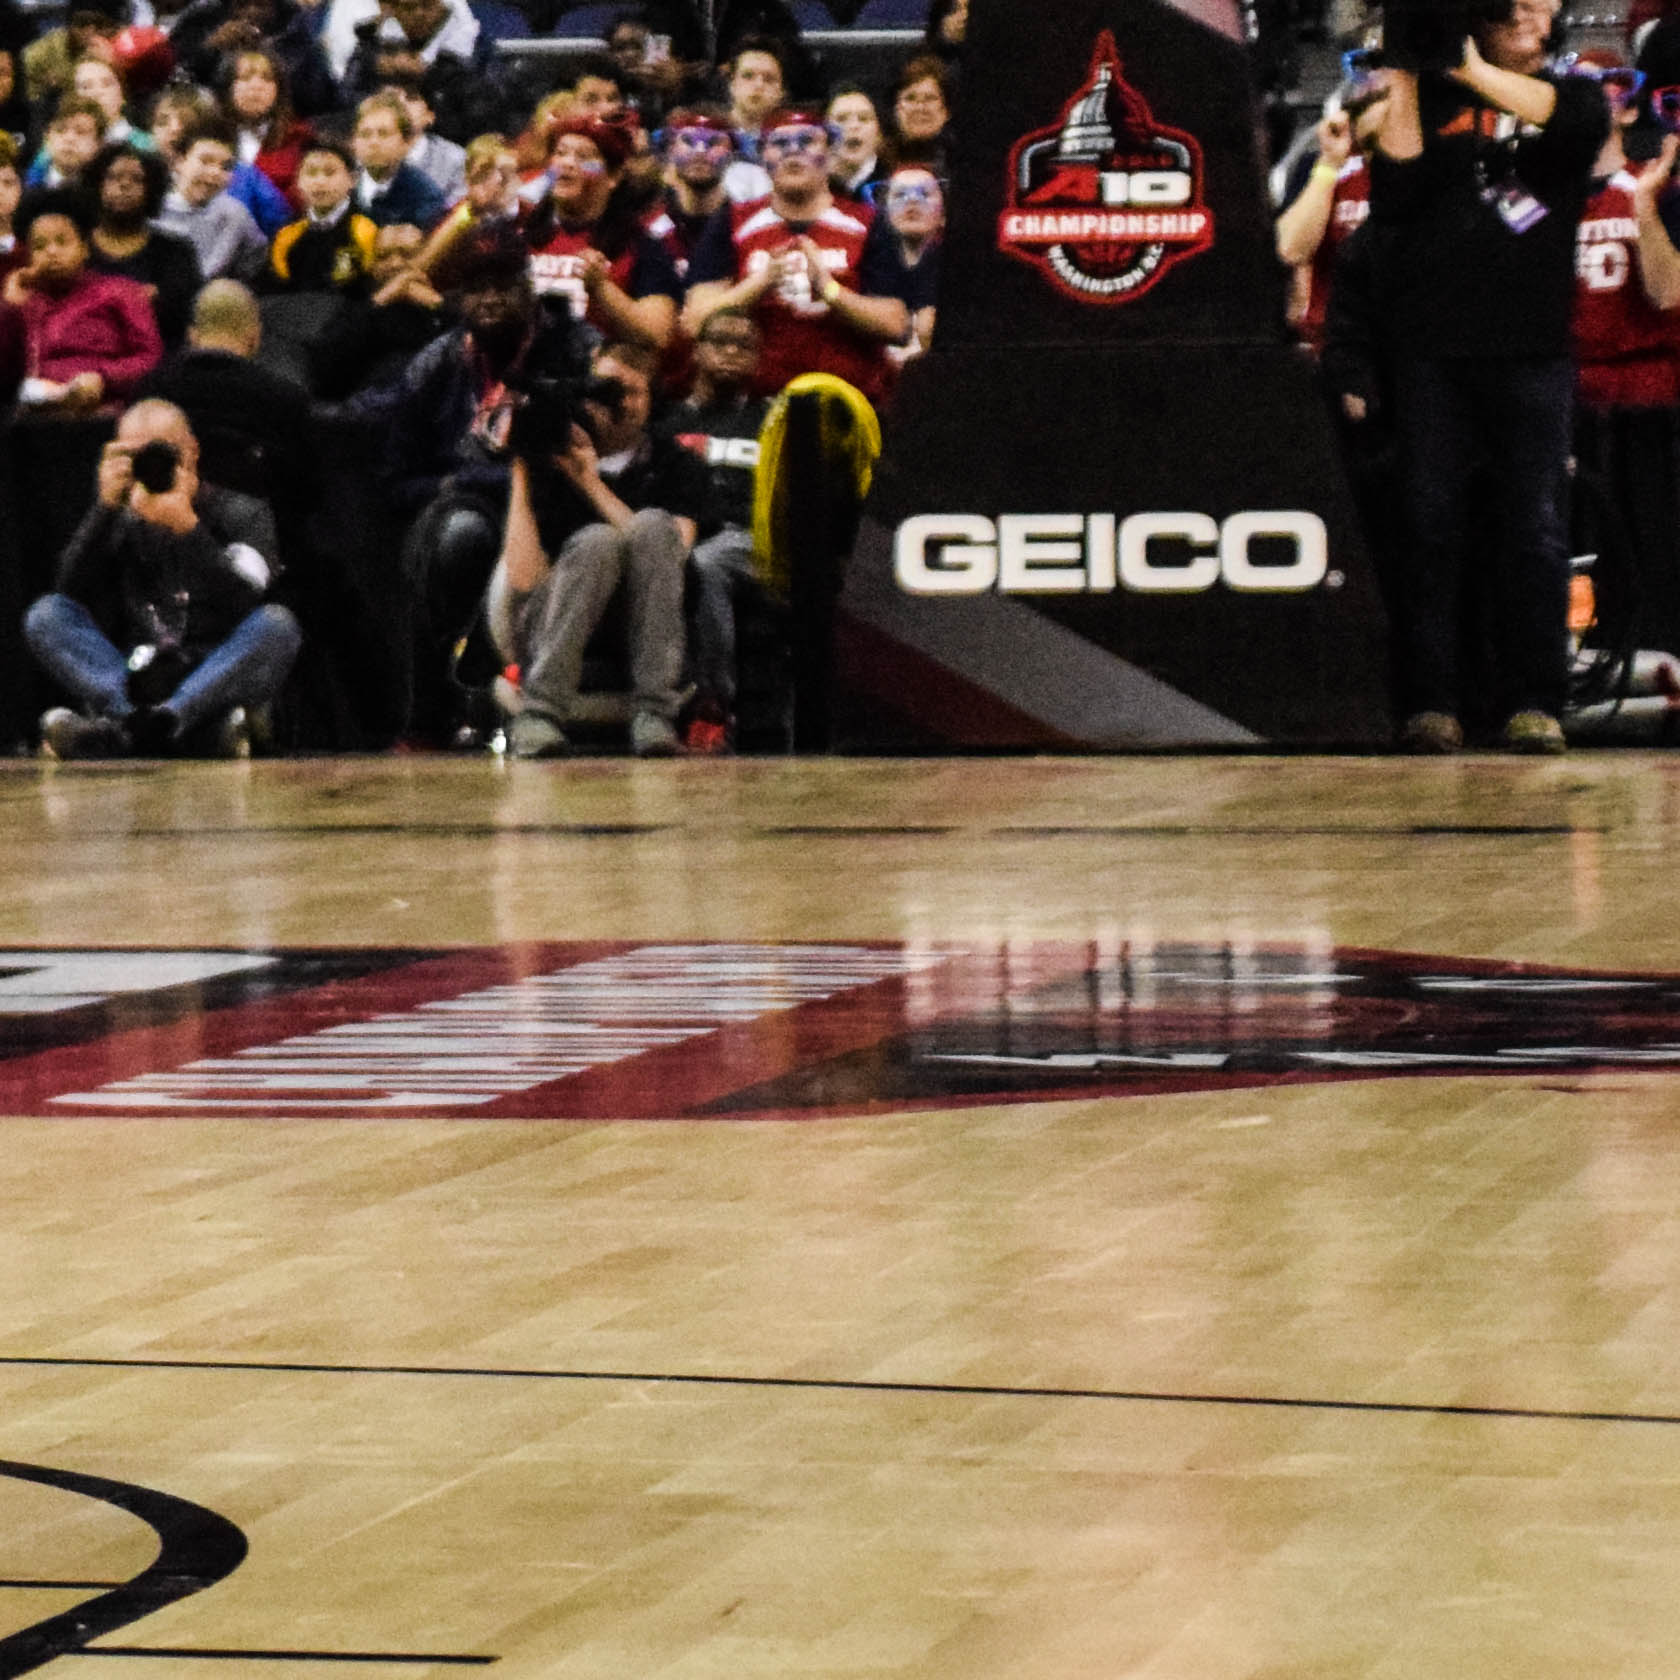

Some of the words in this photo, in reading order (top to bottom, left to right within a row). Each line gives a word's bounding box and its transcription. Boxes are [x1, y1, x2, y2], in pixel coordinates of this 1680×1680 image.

[1023, 164, 1192, 206] A10
[1003, 213, 1208, 237] CHAMPIONSHIP
[893, 510, 1330, 595] GEICO
